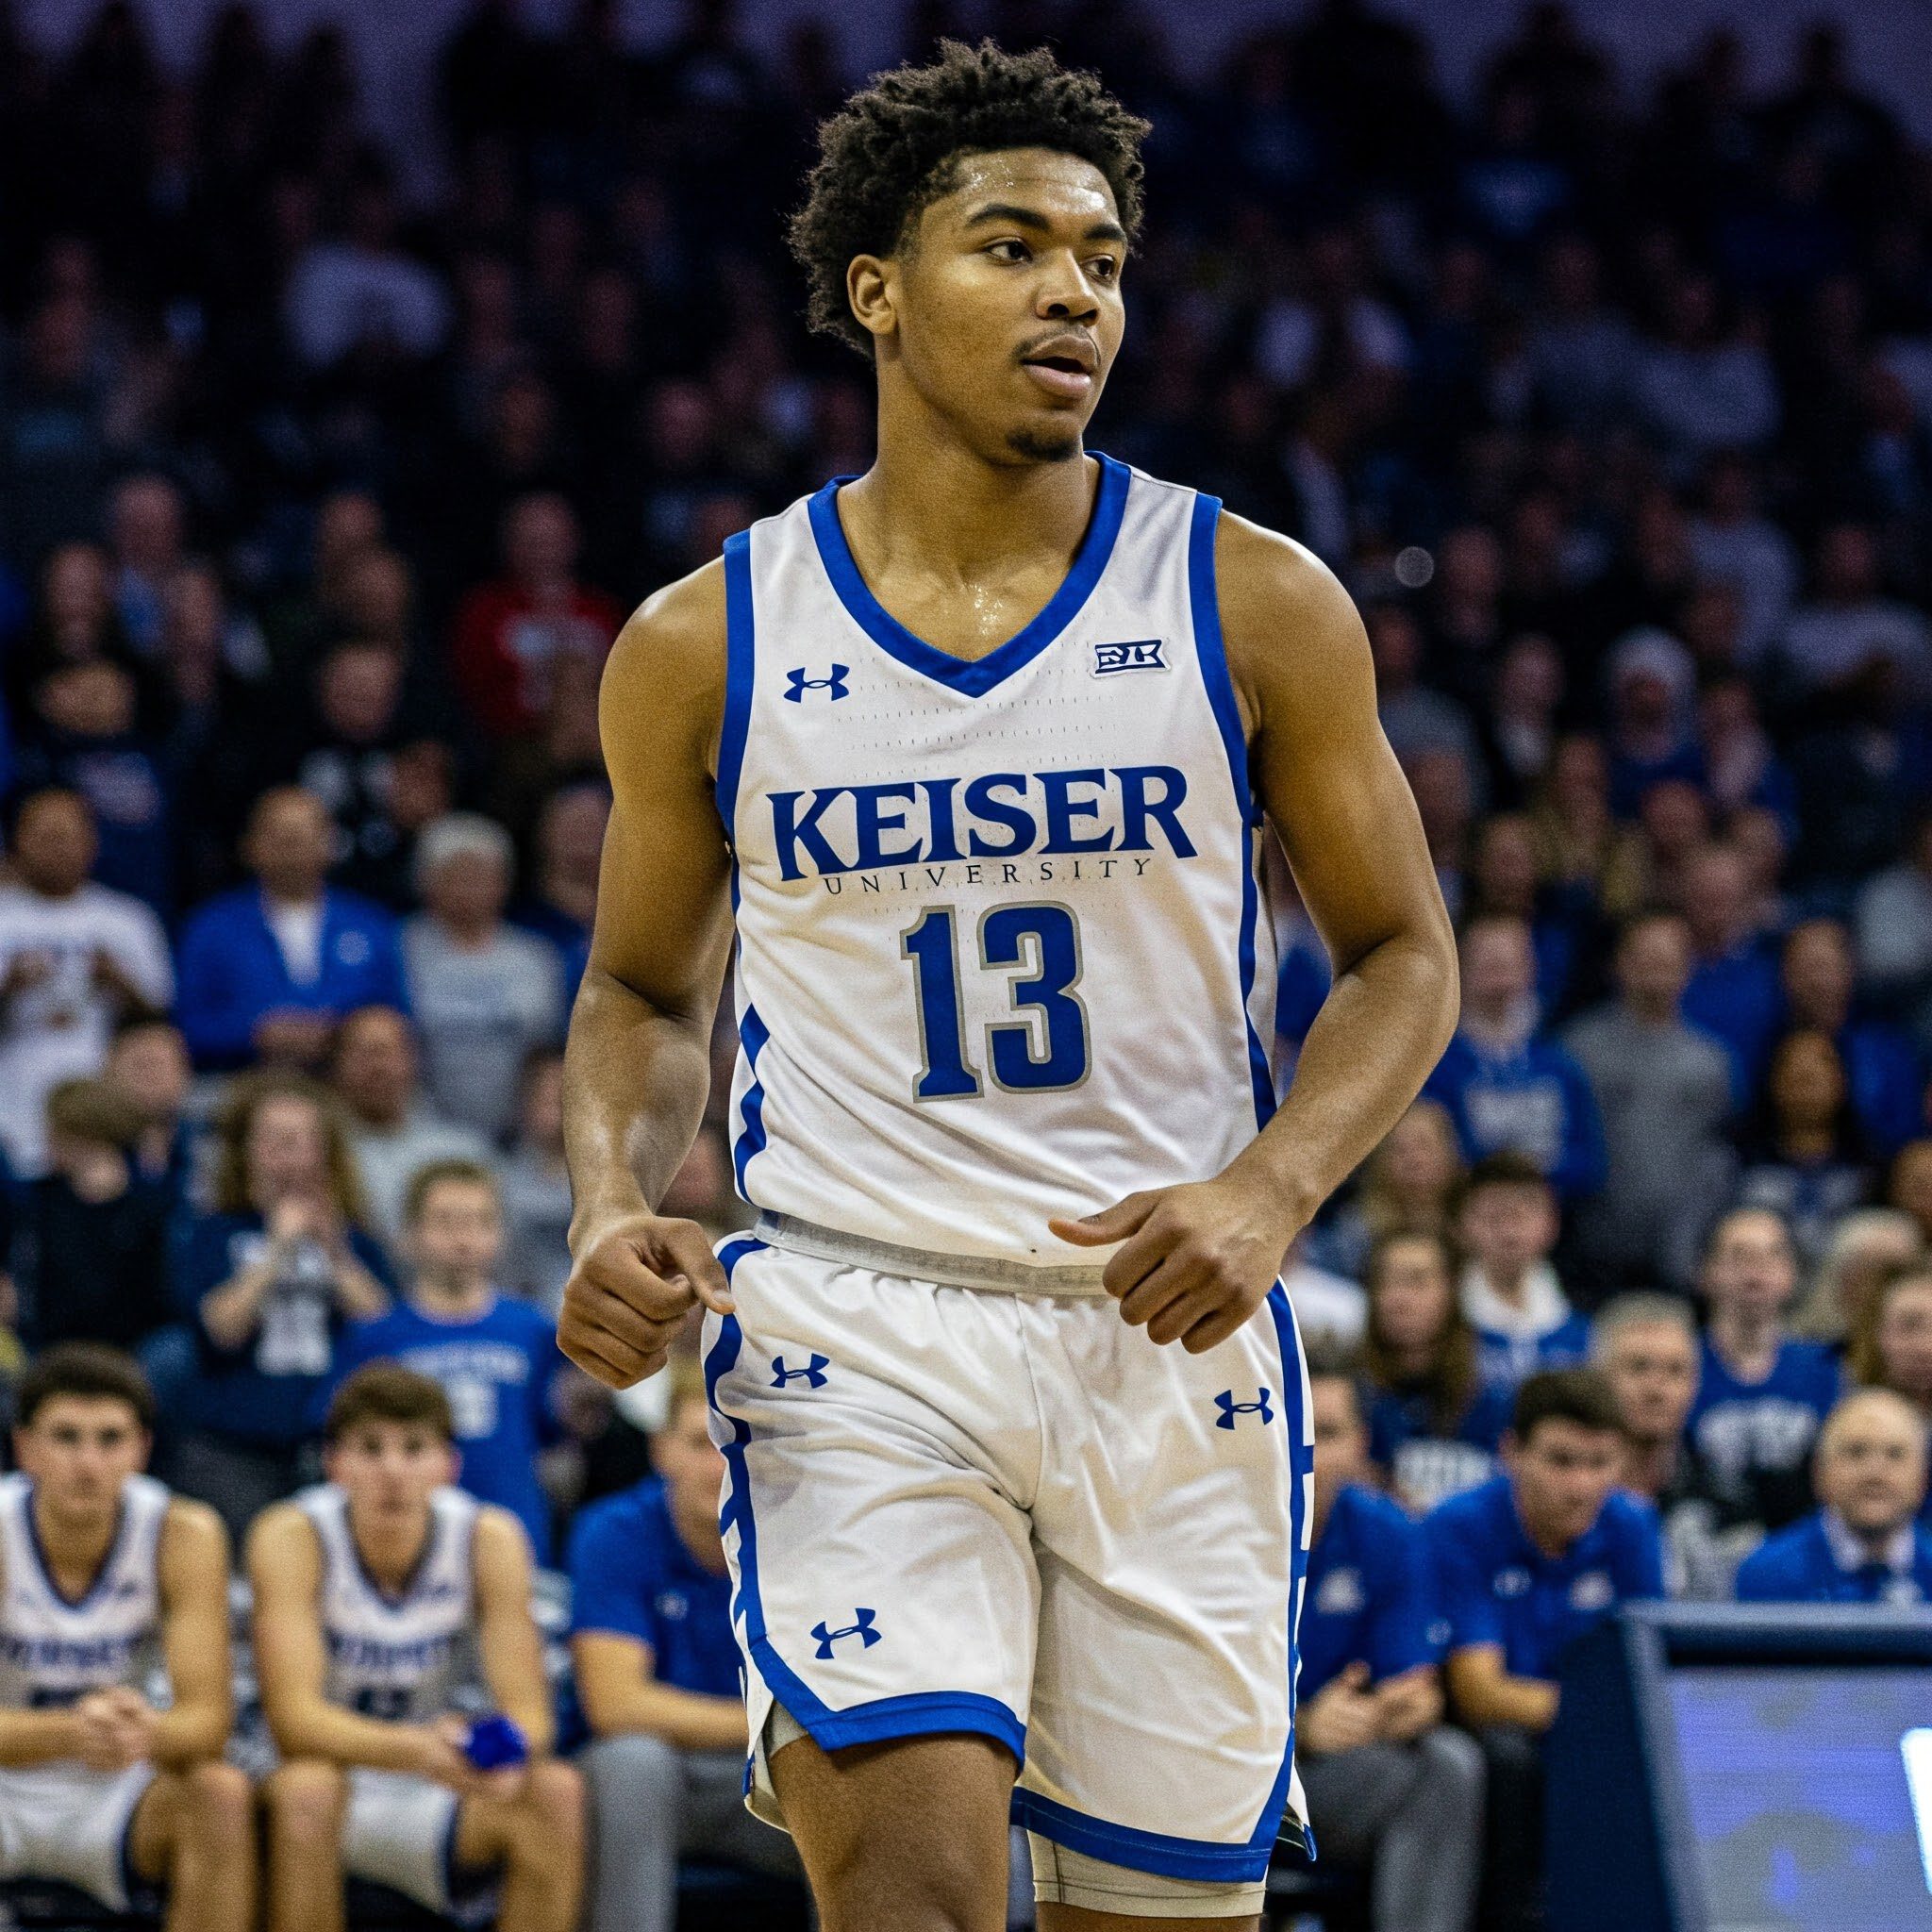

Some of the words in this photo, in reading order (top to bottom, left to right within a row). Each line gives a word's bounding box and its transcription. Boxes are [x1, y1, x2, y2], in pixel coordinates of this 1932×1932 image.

[765, 765, 1198, 882] KEISER
[823, 858, 1151, 895] UNIVERSITY
[900, 900, 1091, 1103] 13
